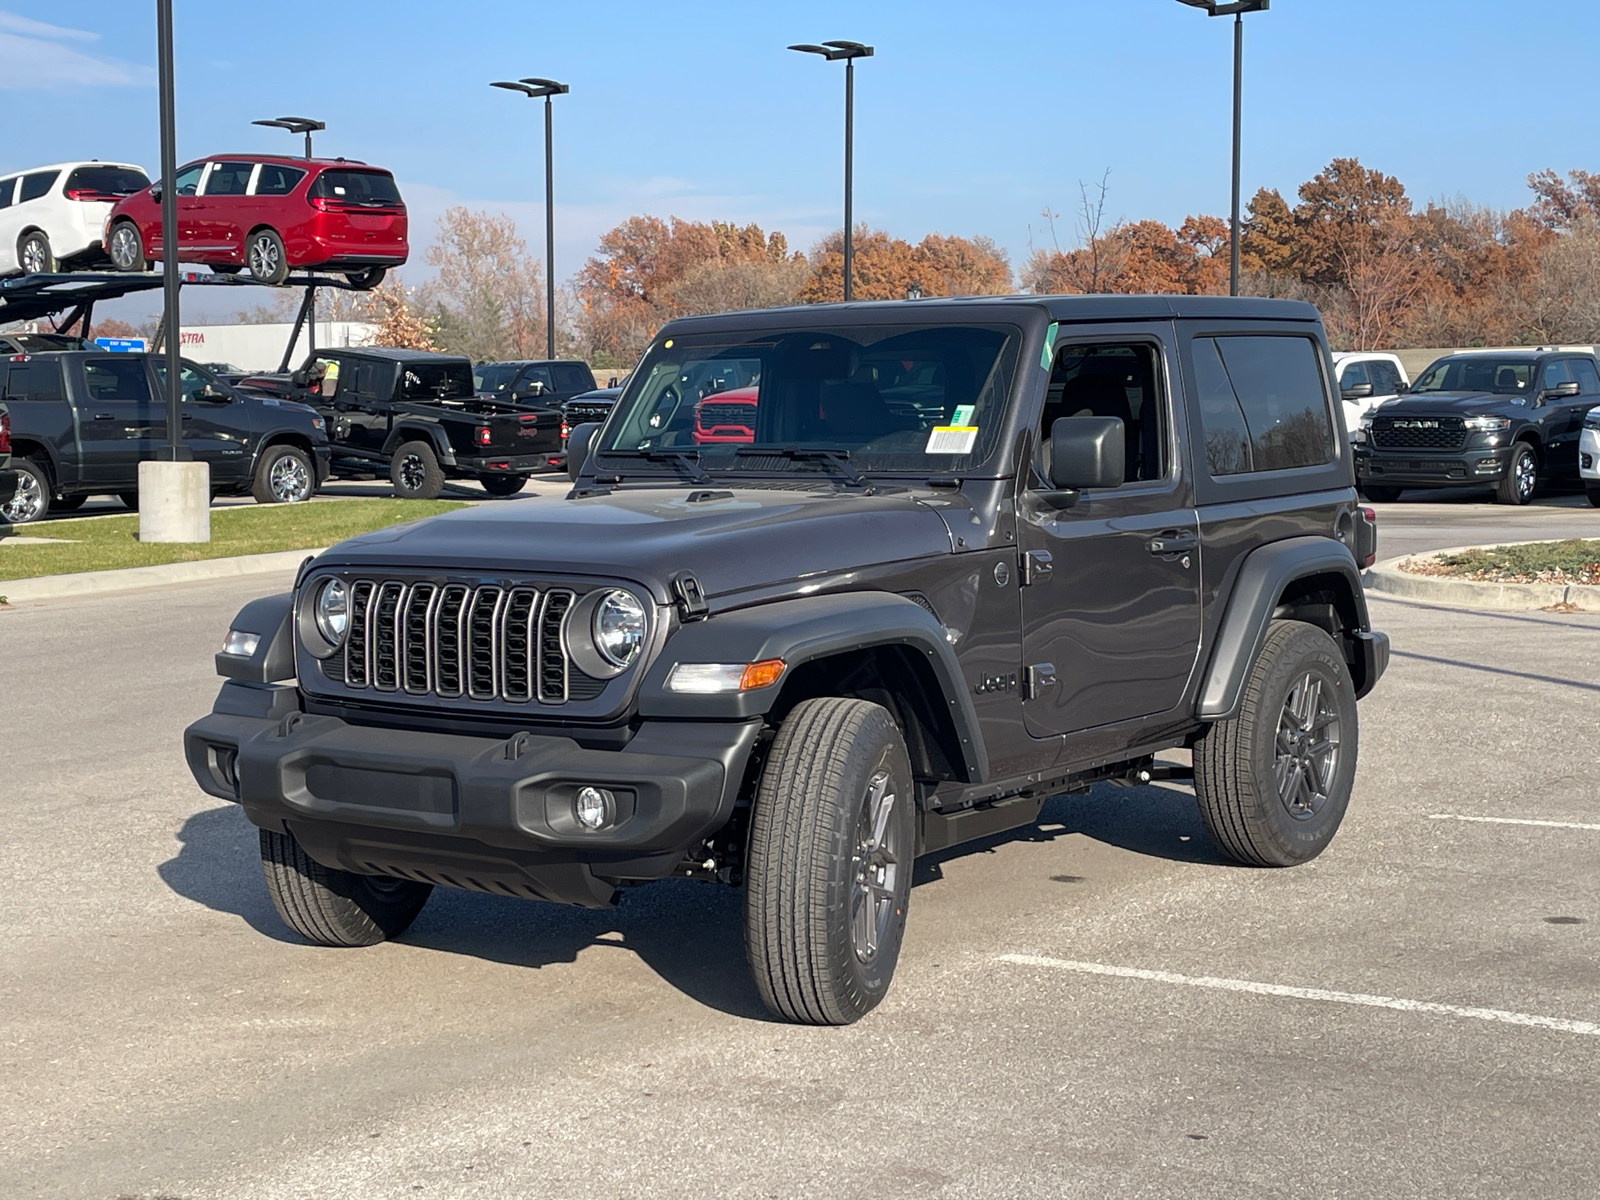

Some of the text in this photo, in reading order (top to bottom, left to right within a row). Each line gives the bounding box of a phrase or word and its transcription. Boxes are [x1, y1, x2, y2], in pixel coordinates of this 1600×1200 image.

[1391, 420, 1439, 429] RAM
[516, 426, 538, 438] Jeep
[974, 670, 1017, 695] Jeep
